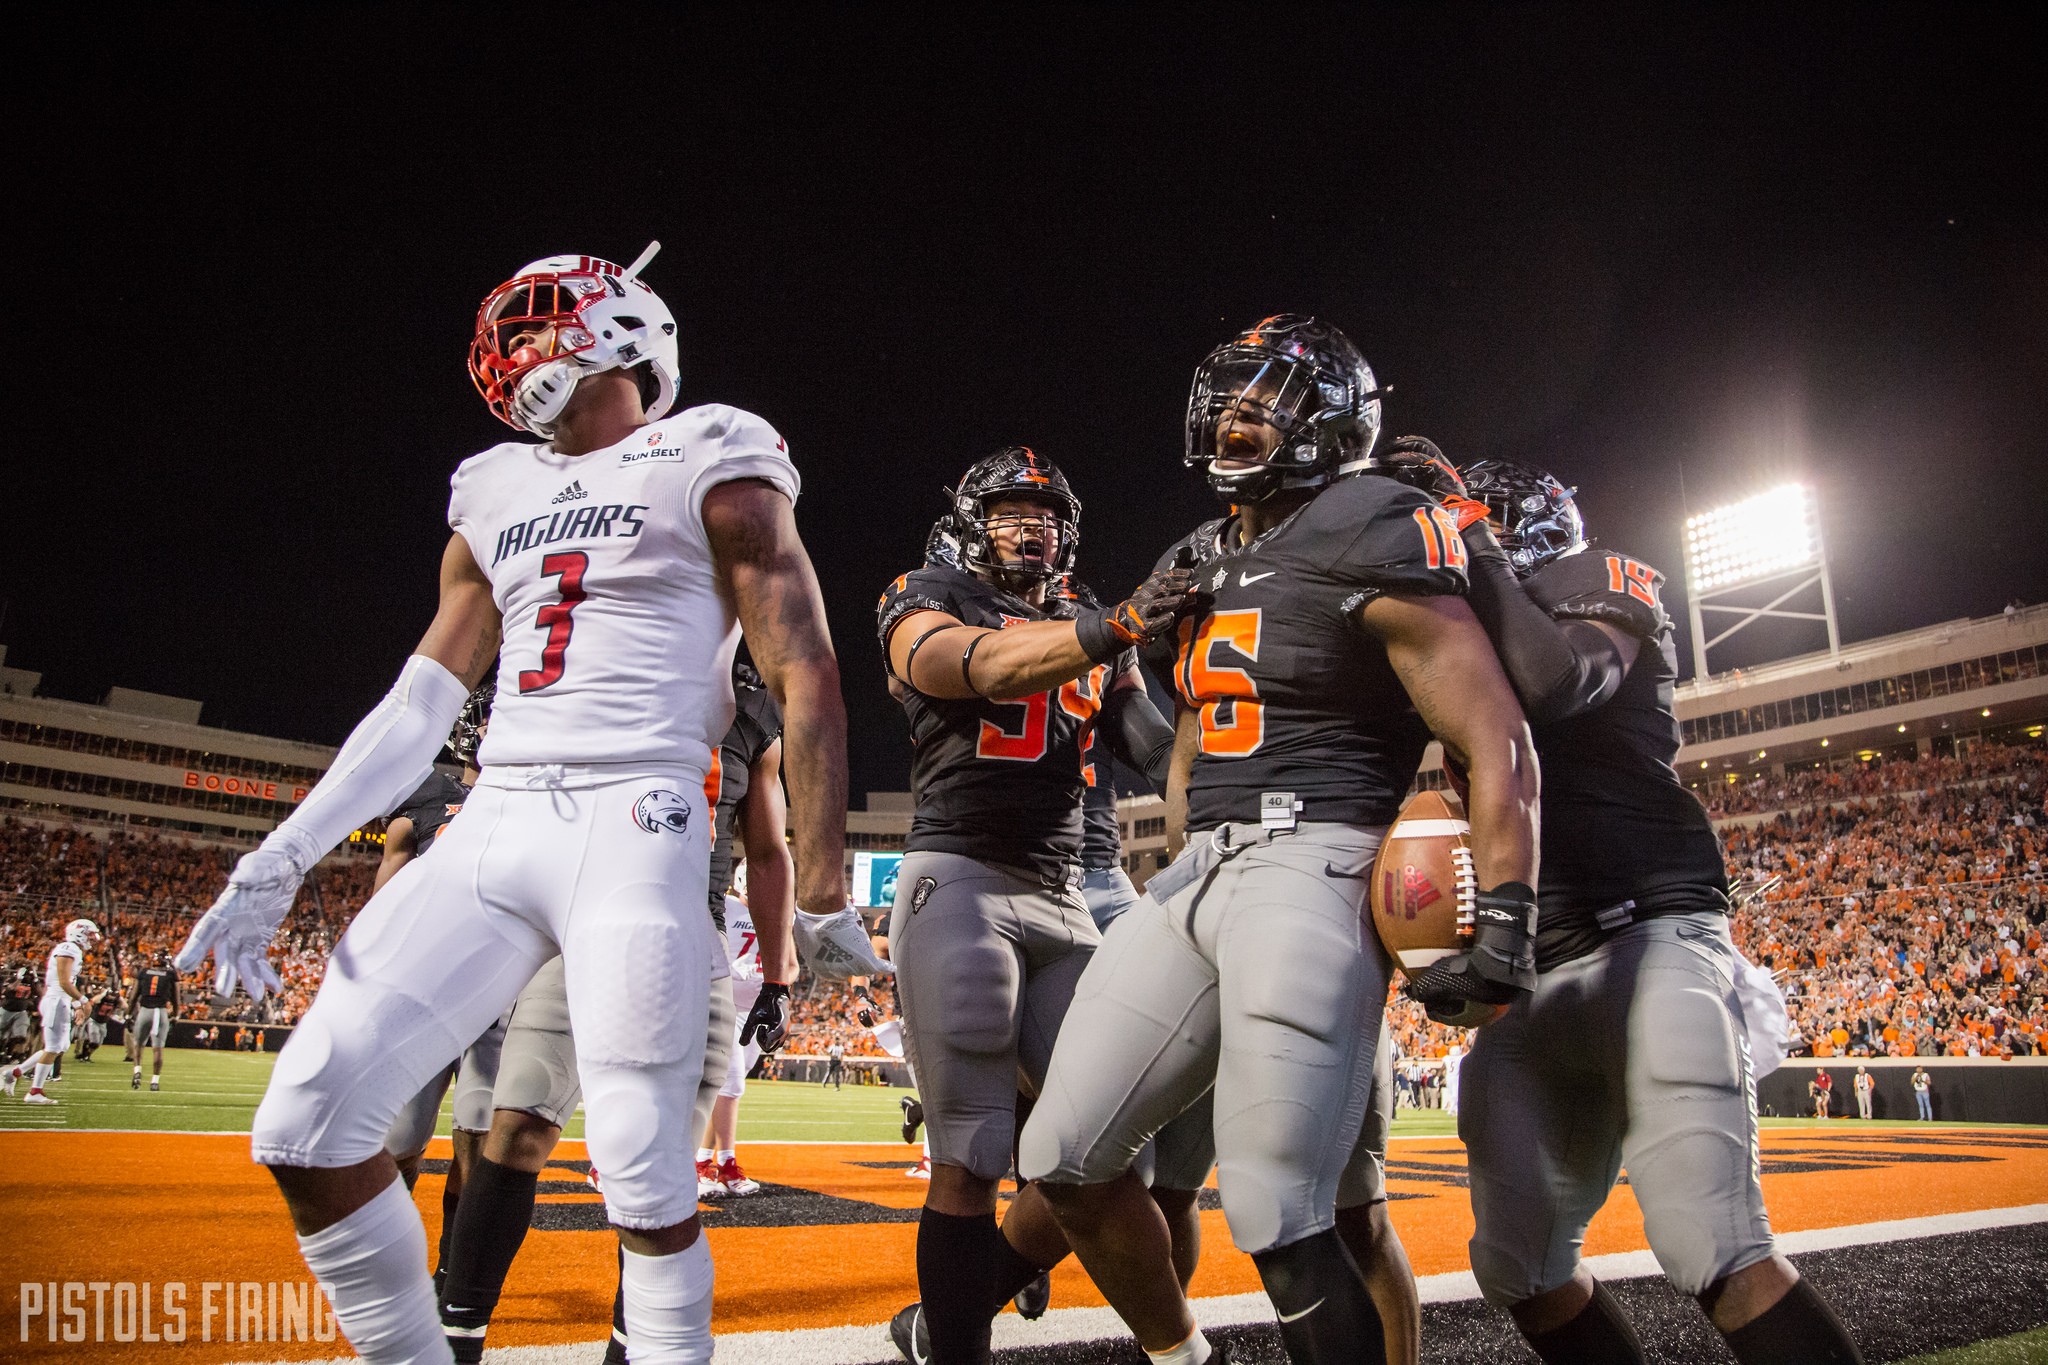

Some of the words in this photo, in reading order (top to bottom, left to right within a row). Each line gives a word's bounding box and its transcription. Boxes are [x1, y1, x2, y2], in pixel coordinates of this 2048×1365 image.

[622, 453, 649, 462] SUN
[651, 448, 681, 458] BELT
[551, 489, 588, 505] adidas
[492, 504, 649, 569] JAGUARS
[1413, 507, 1467, 569] 16
[1605, 556, 1655, 608] 19
[519, 551, 589, 694] 3
[184, 770, 277, 800] BOONE
[1268, 796, 1283, 806] 40
